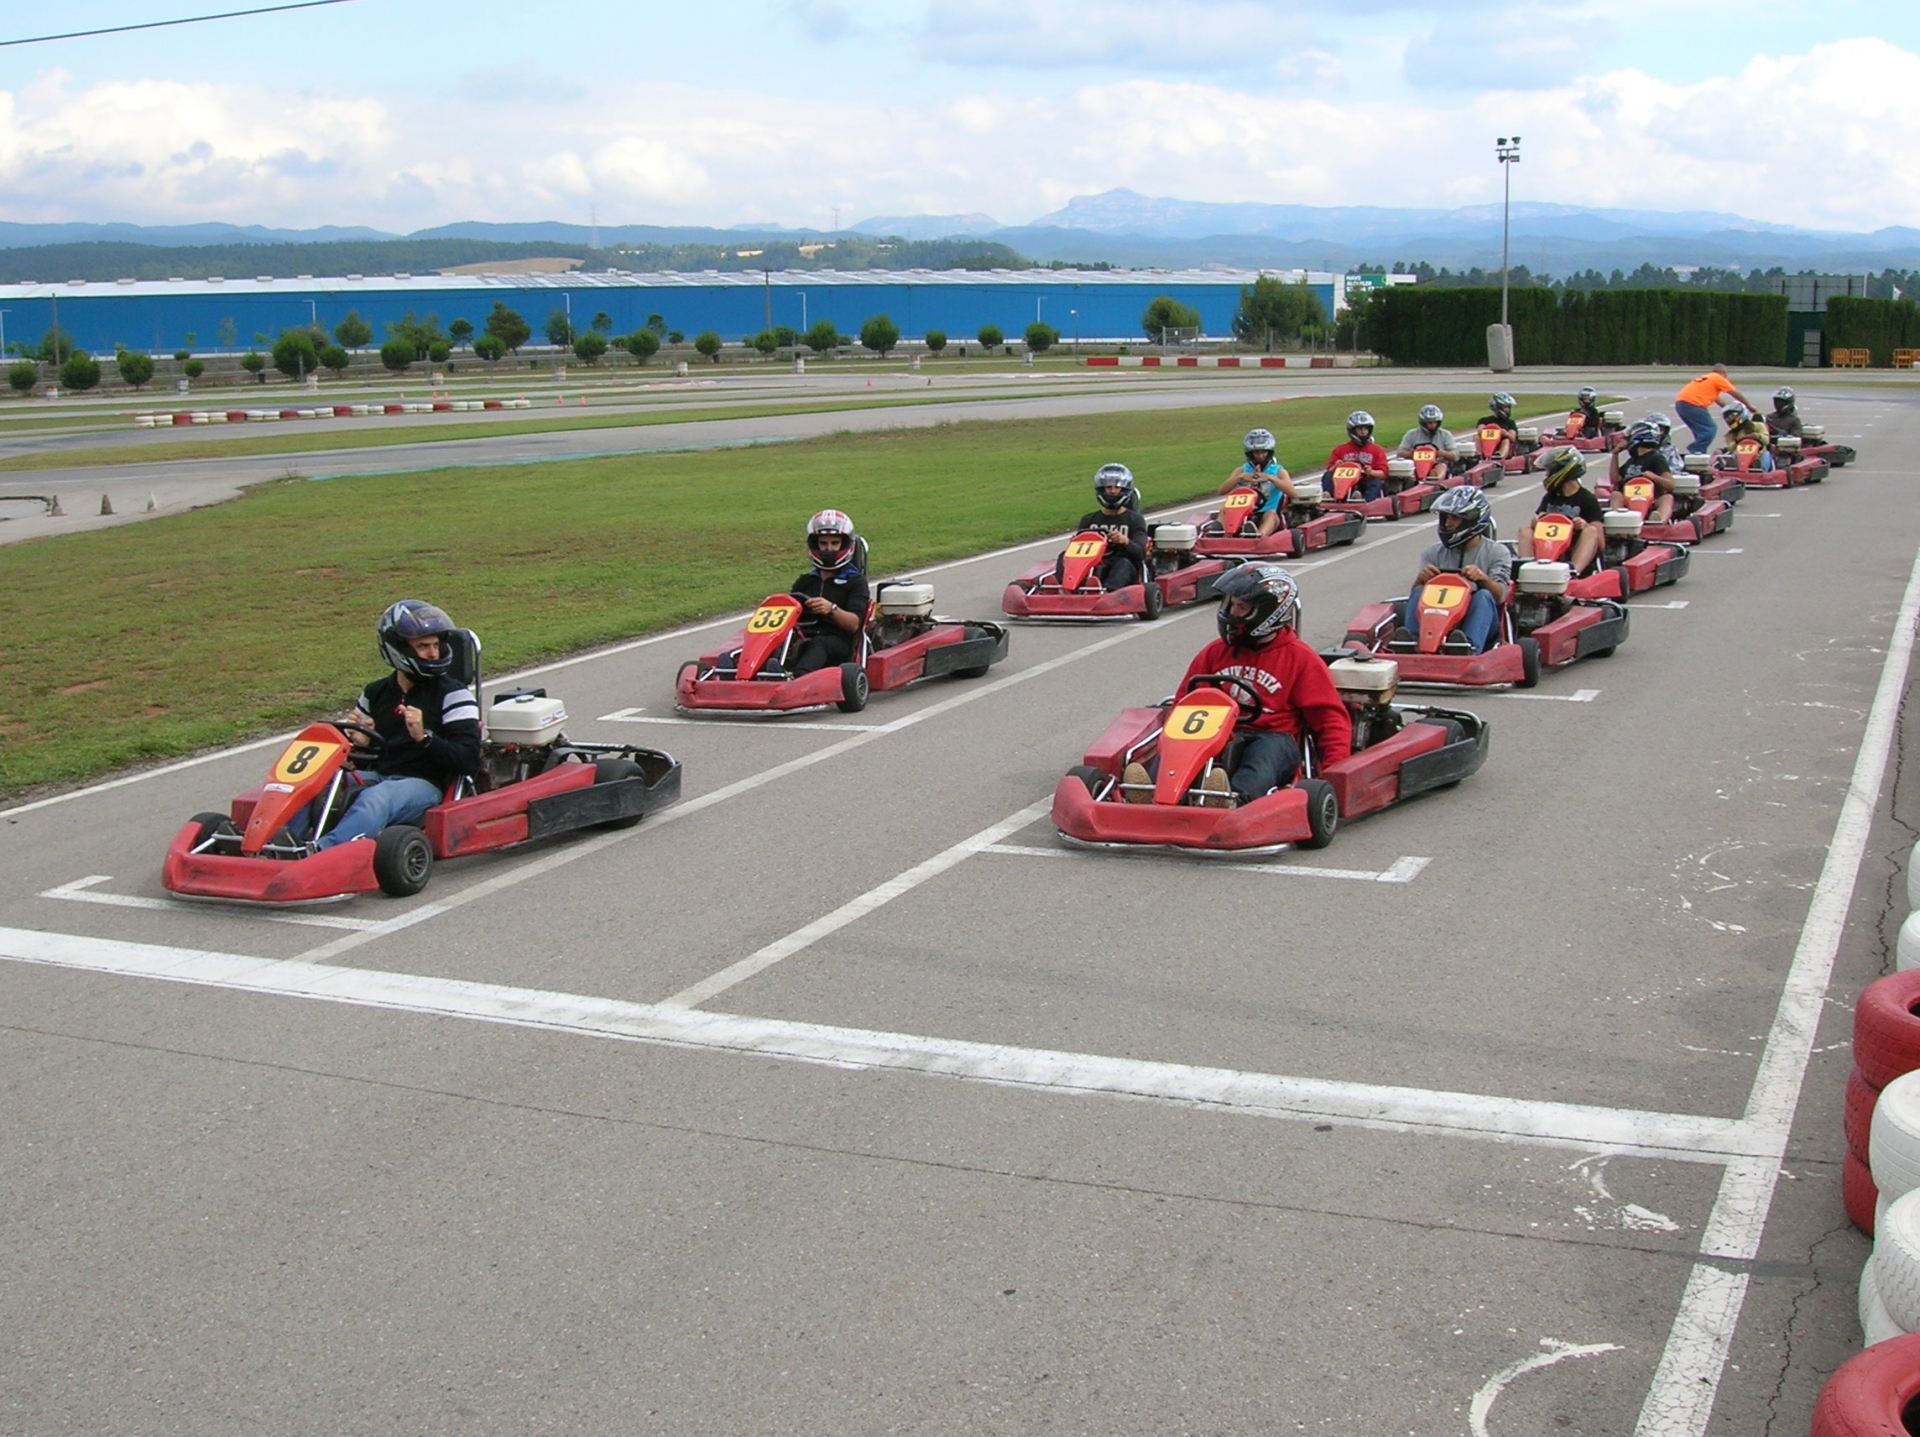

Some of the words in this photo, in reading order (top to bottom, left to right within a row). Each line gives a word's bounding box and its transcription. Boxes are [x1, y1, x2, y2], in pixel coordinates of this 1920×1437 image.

[1337, 469, 1355, 477] 20
[1633, 486, 1641, 495] 2
[1230, 495, 1248, 506] 13
[1546, 525, 1559, 538] 3
[1075, 542, 1094, 555] 11
[1437, 588, 1448, 604] 1
[753, 609, 788, 629] 33
[1182, 710, 1209, 735] 6
[286, 745, 320, 775] 8
